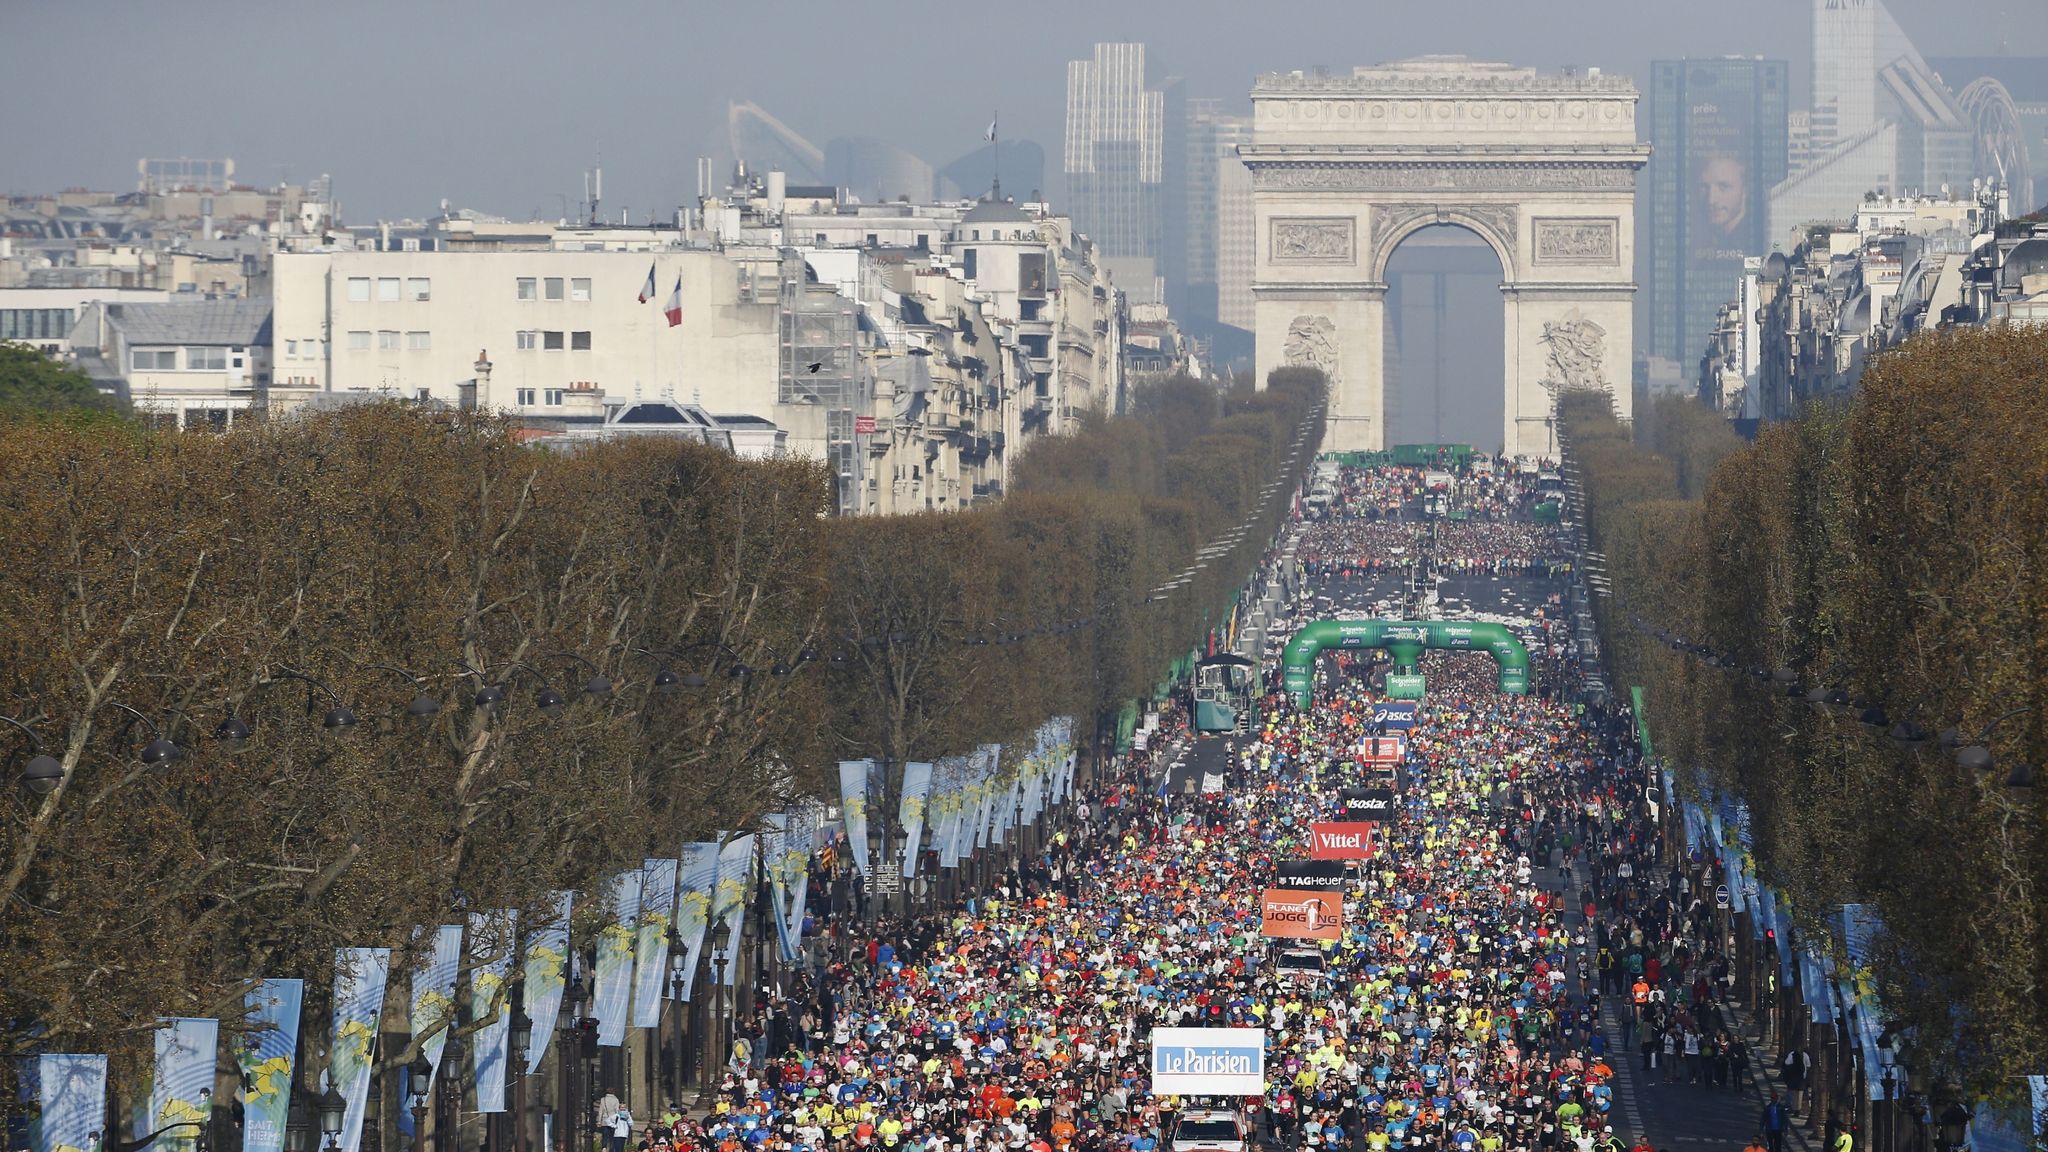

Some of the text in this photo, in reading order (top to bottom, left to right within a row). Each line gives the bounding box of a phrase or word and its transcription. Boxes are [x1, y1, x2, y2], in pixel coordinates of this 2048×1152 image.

[1387, 709, 1413, 721] asics
[1320, 832, 1362, 848] Vittel
[1266, 904, 1309, 913] PLANET
[1266, 913, 1338, 925] JOGGNG
[1165, 1047, 1251, 1073] Le Parisien
